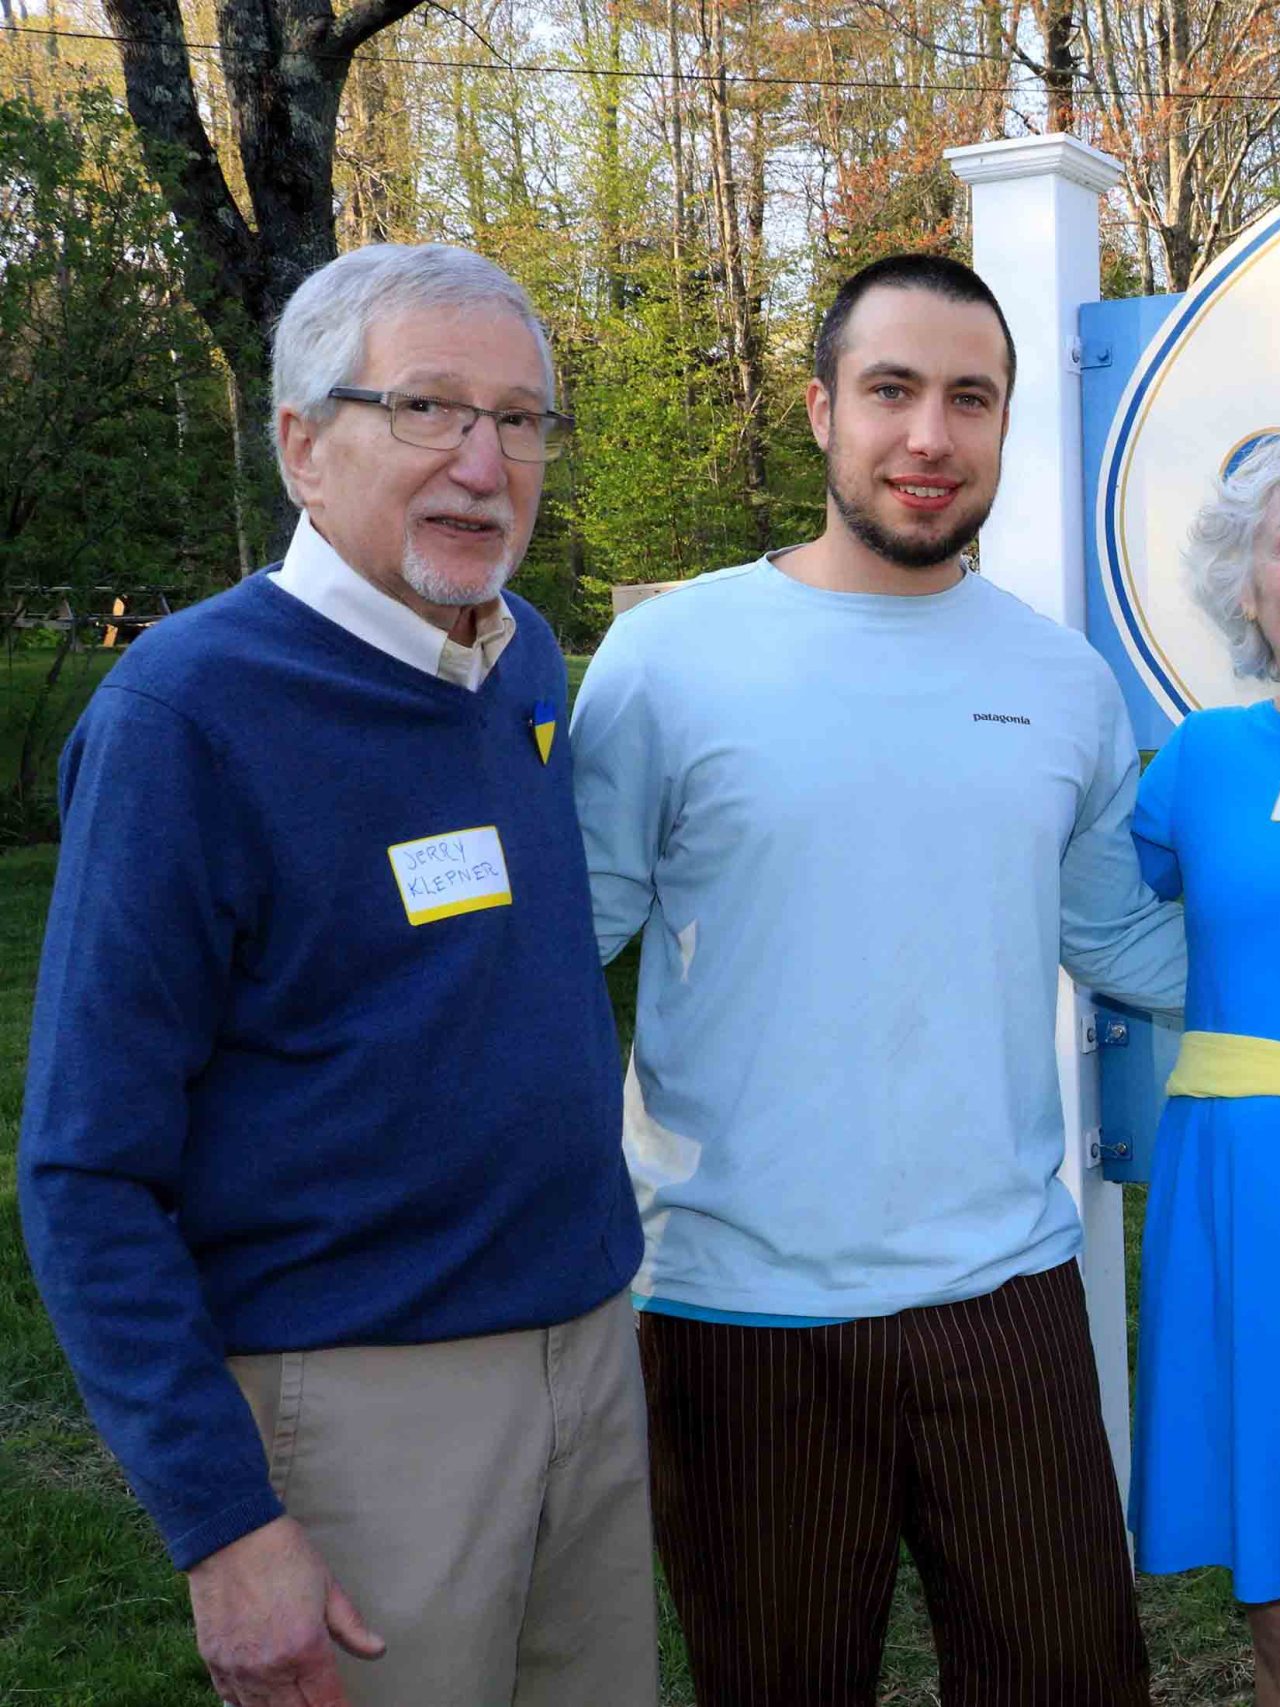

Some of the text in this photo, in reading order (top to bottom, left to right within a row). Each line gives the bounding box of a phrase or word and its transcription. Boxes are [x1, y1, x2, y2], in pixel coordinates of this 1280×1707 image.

[973, 713, 1031, 725] patagonia
[403, 838, 467, 870] JERRY
[407, 861, 499, 897] KLEPNER
